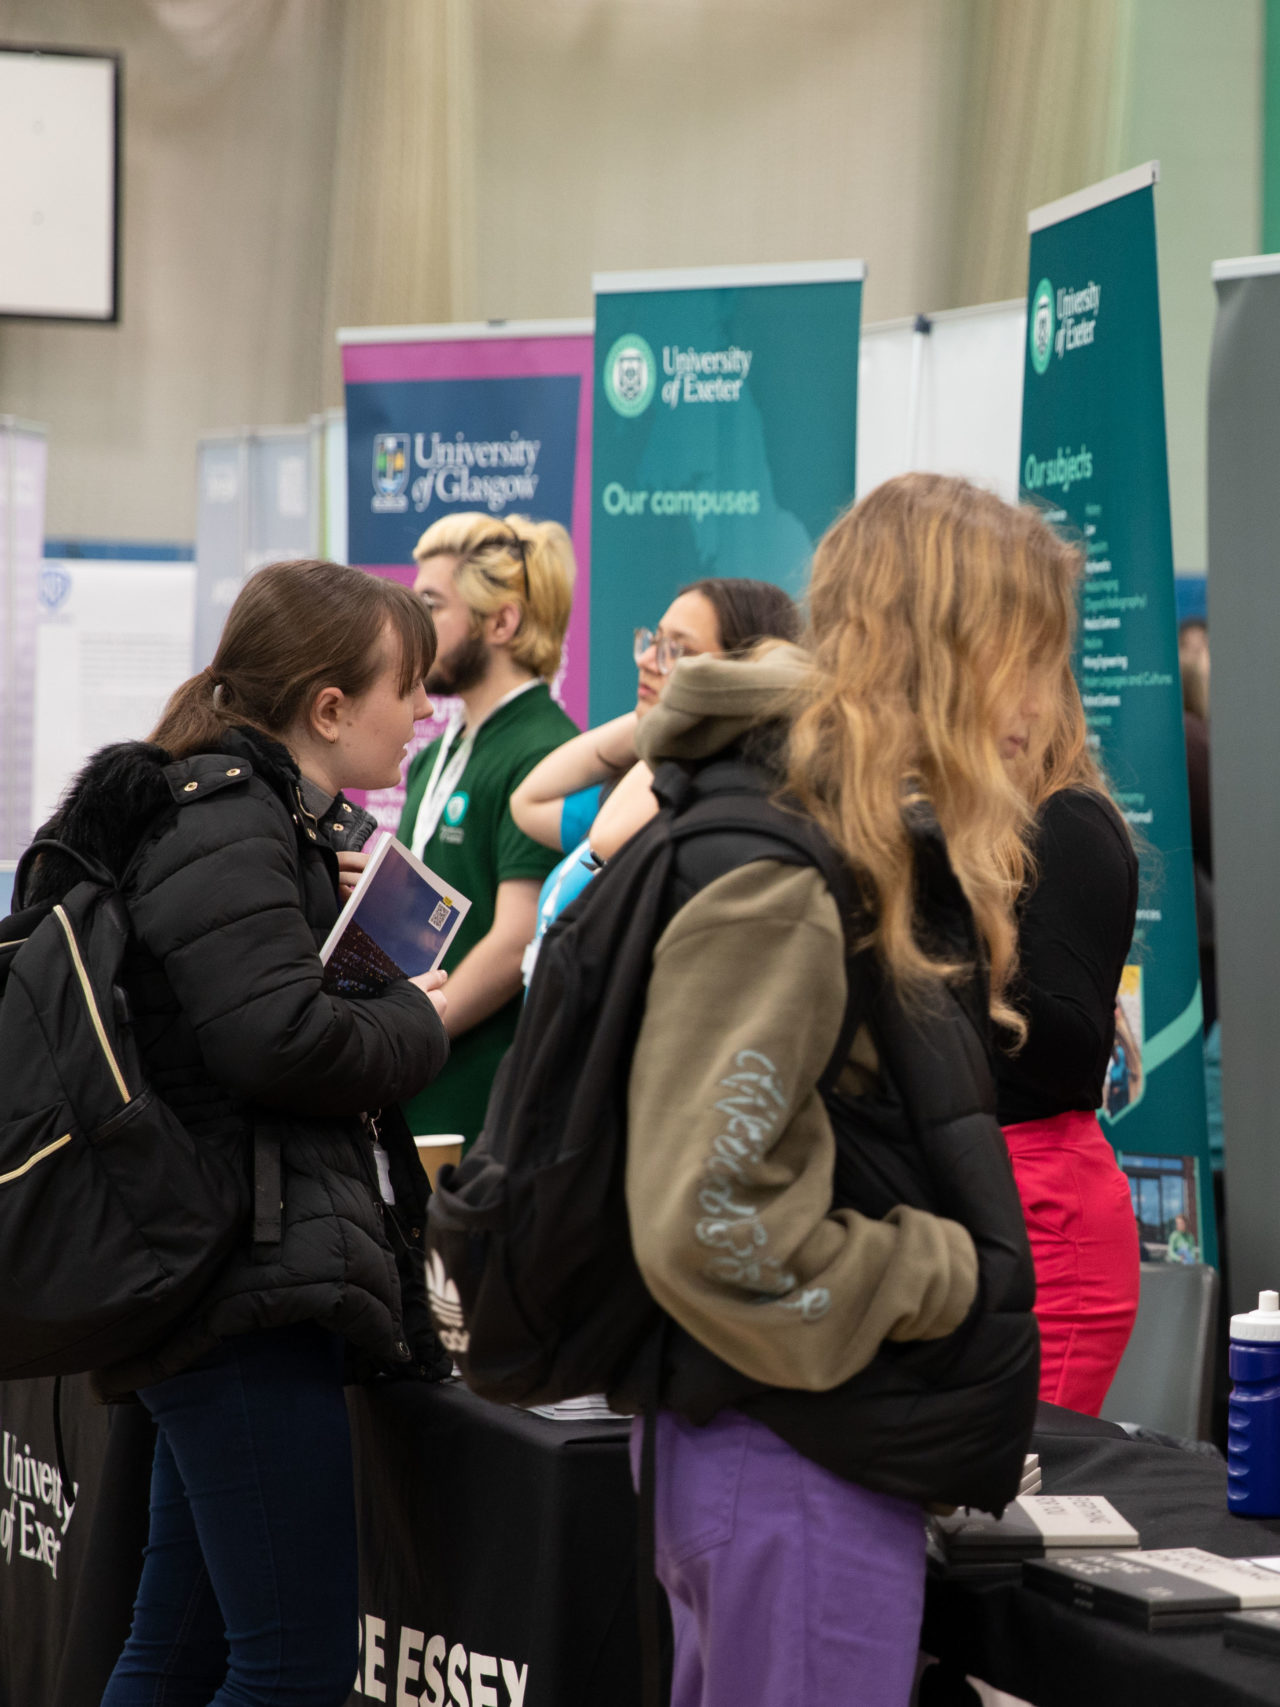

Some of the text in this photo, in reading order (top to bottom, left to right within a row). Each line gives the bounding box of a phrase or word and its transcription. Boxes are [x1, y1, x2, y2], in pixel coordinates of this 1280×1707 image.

[1056, 280, 1101, 320] University
[663, 345, 752, 378] University
[662, 375, 743, 409] of Exeter
[415, 430, 541, 475] University
[411, 466, 540, 512] of Glasgow
[603, 482, 760, 520] Our campuses
[0, 1492, 18, 1565] of
